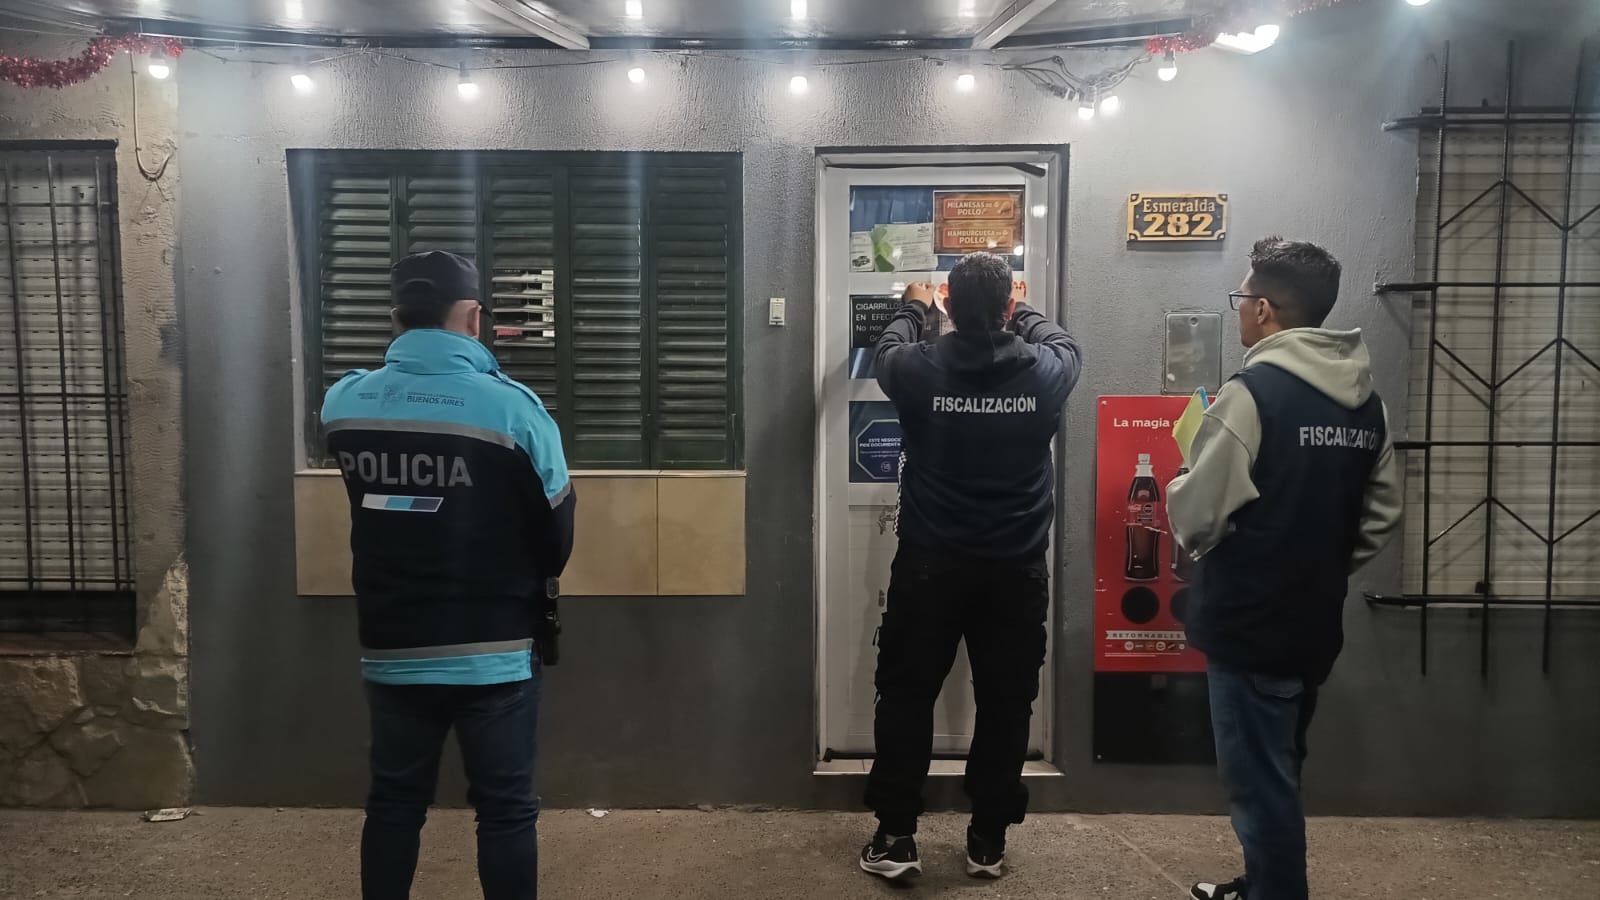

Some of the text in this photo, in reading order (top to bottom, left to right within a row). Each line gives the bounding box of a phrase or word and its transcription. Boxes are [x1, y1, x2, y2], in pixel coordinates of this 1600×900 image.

[947, 201, 985, 209] MILANESAS
[1143, 199, 1216, 212] Esmeralda
[1143, 213, 1213, 236] 282
[856, 313, 867, 321] EN
[407, 395, 439, 404] BUENOS
[440, 398, 465, 407] AIRES
[933, 394, 1036, 413] FISCALIZACIÓN
[1113, 418, 1129, 428] La
[1132, 418, 1170, 429] magia
[338, 450, 473, 487] POLICIA
